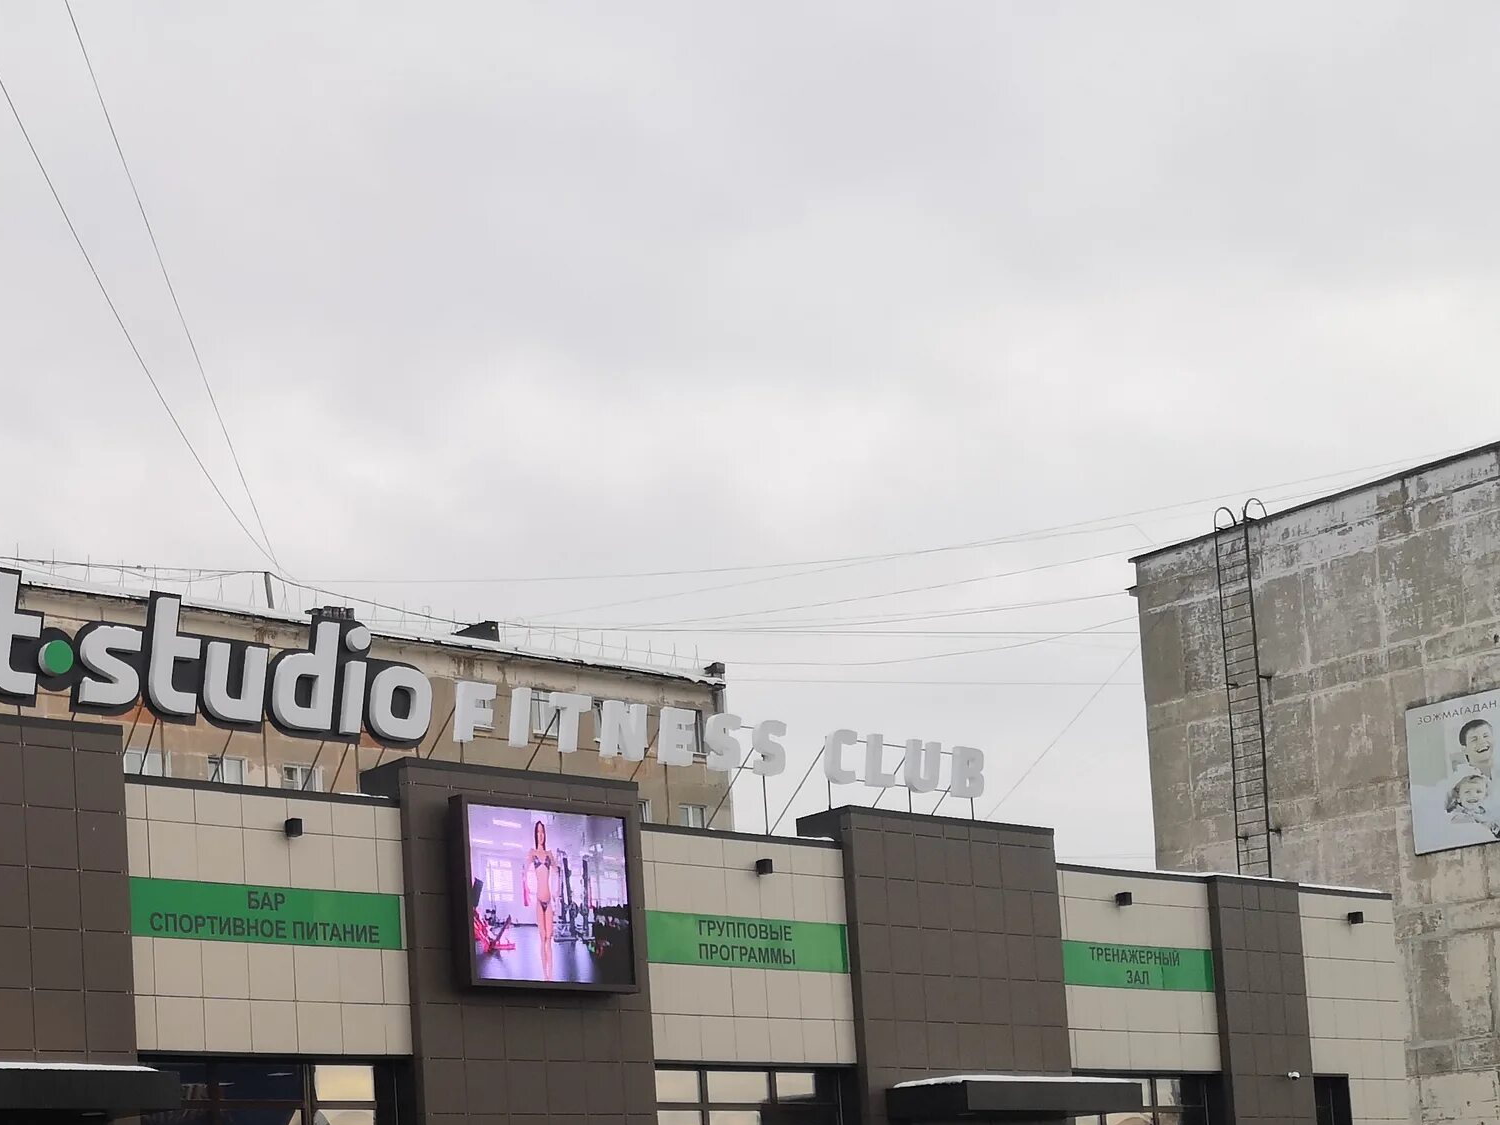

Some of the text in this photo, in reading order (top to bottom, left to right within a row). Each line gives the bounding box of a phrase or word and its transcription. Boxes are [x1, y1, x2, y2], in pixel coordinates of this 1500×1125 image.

[453, 681, 985, 798] FITNESS CLUB
[247, 890, 285, 911] БАР
[150, 912, 380, 944] СПОРТИВНОЕ ПИТАНИЕ
[698, 919, 792, 941] ГРУППОВЫЕ
[699, 943, 796, 965] ПРОГРАММЫ
[1089, 946, 1180, 966] ТРЕНАЖЕРНЫЙ
[1126, 969, 1150, 985] ЗАЛ
